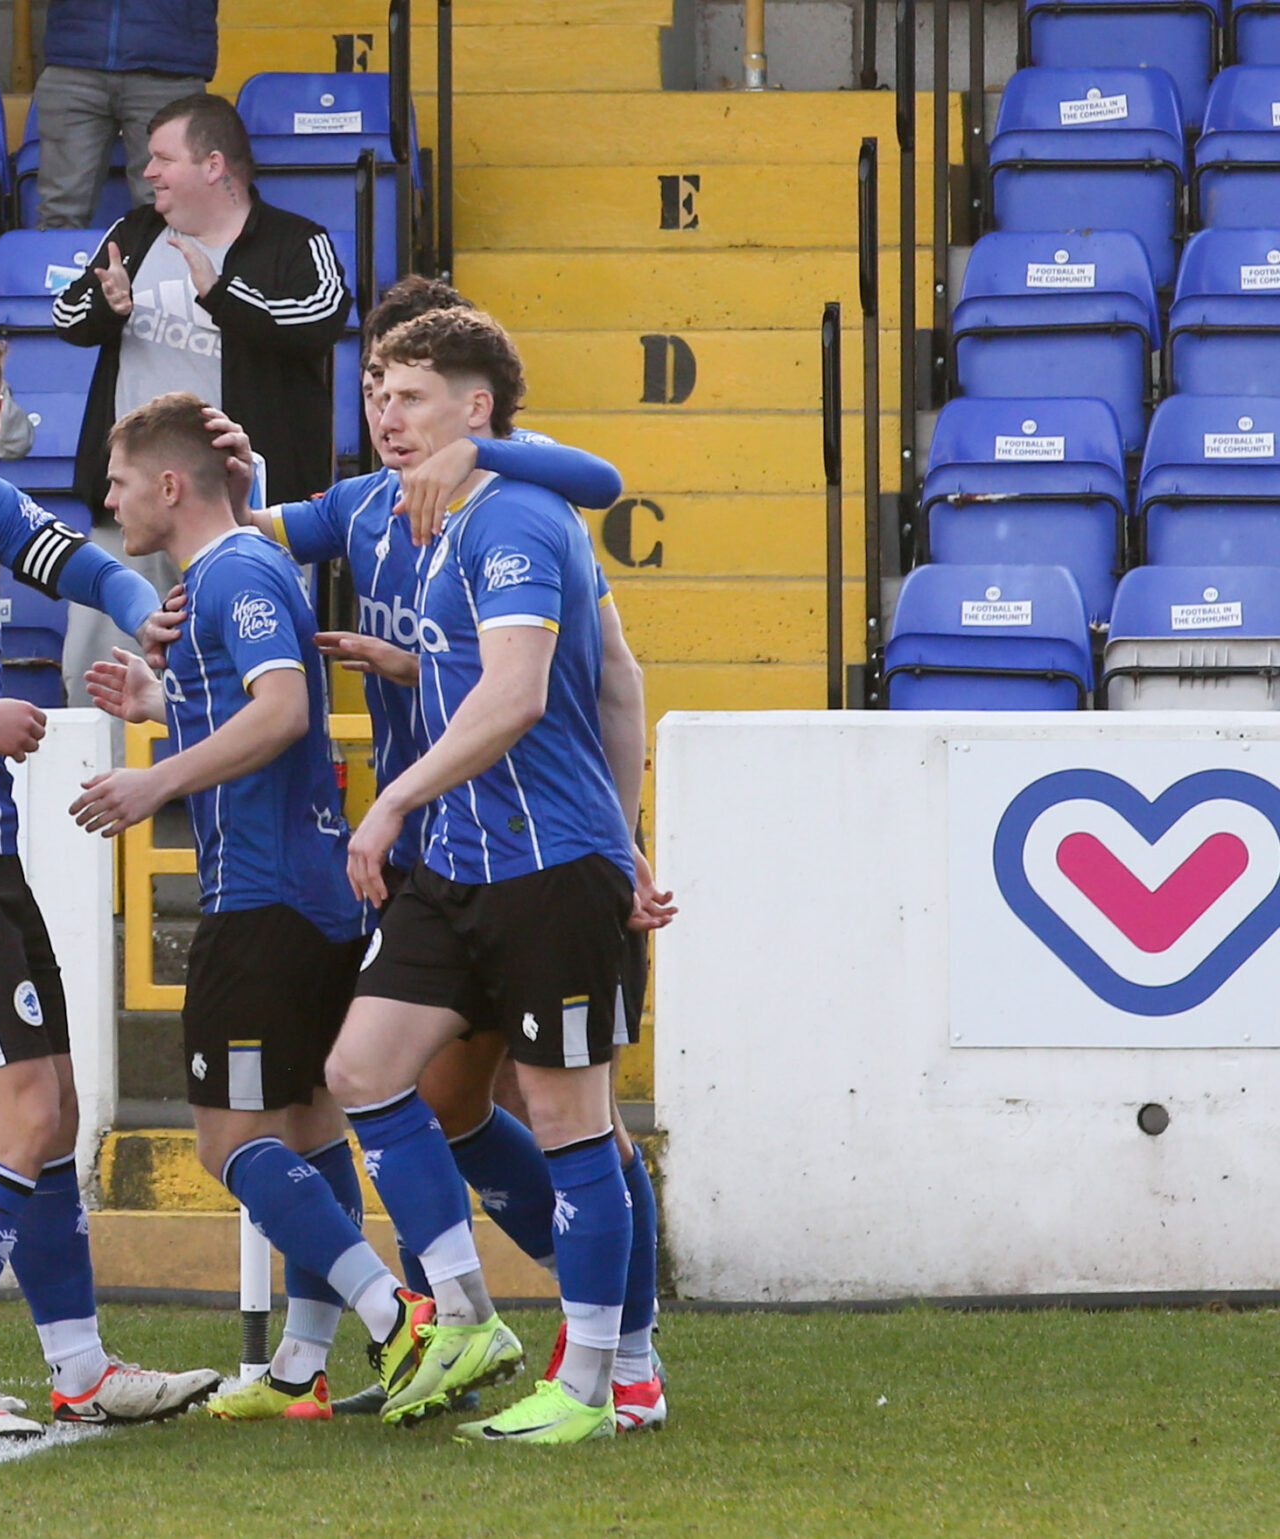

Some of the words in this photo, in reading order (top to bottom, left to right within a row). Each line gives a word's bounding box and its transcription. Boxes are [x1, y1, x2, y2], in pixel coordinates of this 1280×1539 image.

[1069, 101, 1107, 111] FOOTBALL
[1109, 99, 1118, 107] IN
[1063, 112, 1078, 121] THE
[1080, 107, 1126, 118] COMMUNITY
[657, 175, 700, 230] E
[1035, 267, 1075, 275] FOOTBALL
[1076, 267, 1086, 275] IN
[1028, 275, 1043, 283] THE
[1045, 275, 1092, 283] COMMUNITY
[640, 335, 697, 404] D
[1212, 437, 1252, 445] FOOTBALL
[998, 448, 1013, 456] THE
[1014, 448, 1062, 456] COMMUNITY
[1223, 445, 1271, 453] COMMUNITY
[602, 498, 665, 568] C
[232, 594, 276, 622] Hope
[1013, 605, 1023, 613] IN
[1180, 607, 1220, 616] FOOTBALL
[1222, 606, 1232, 614] IN
[964, 613, 980, 621] THE
[981, 613, 1030, 621] COMMUNITY
[1173, 617, 1190, 625] THE
[1192, 614, 1239, 624] COMMUNITY
